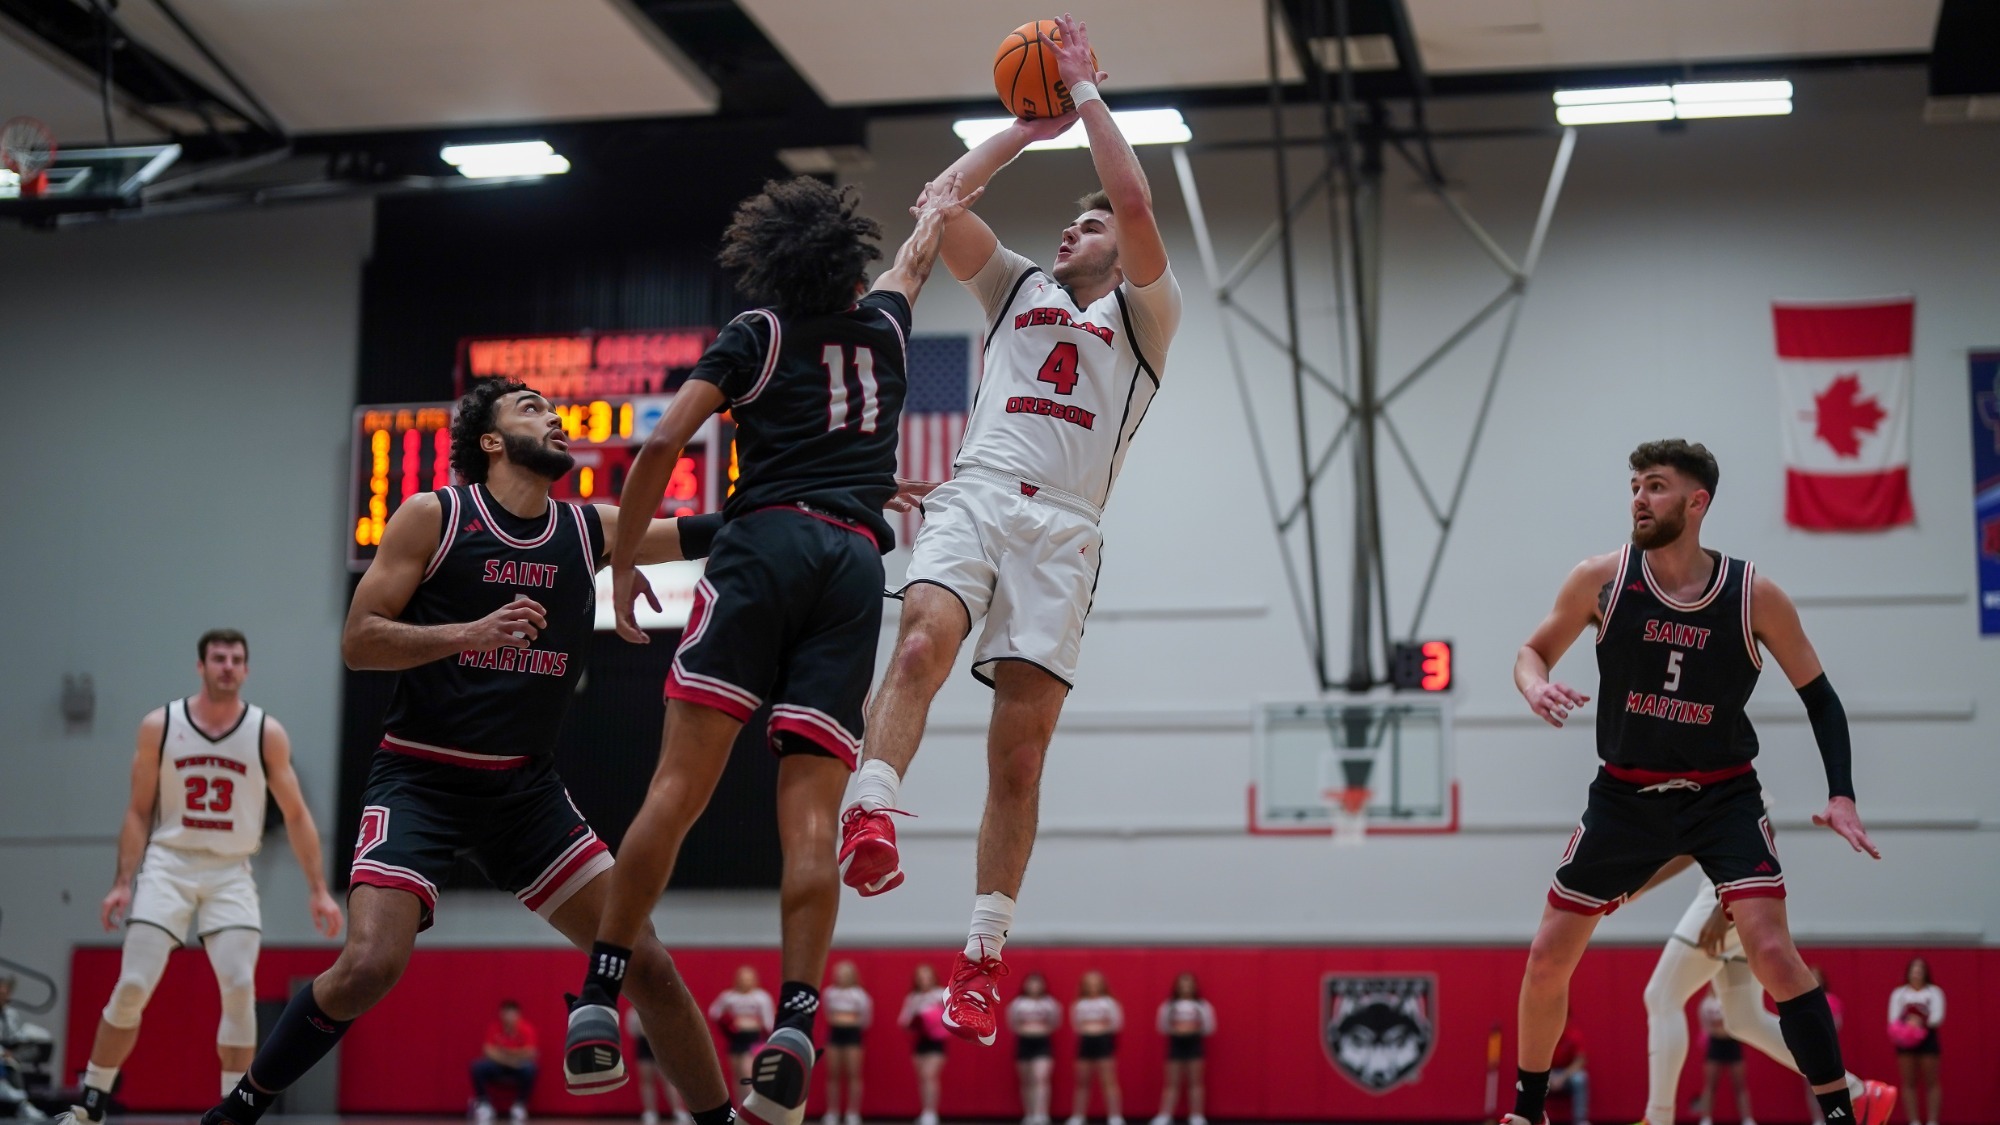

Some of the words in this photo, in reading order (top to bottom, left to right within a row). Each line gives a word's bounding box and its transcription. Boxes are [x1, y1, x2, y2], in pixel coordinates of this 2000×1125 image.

[509, 366, 668, 398] NIVERSITY
[1037, 341, 1079, 395] 4
[820, 343, 880, 434] 11
[1005, 396, 1096, 431] OREGON
[1020, 481, 1040, 497] W
[483, 559, 558, 588] SAINT
[1643, 619, 1711, 650] SAINT
[458, 646, 568, 677] MARTINS
[1421, 641, 1451, 691] 3
[1662, 650, 1684, 692] 5
[1625, 691, 1714, 725] MARTINS
[184, 774, 234, 813] 23
